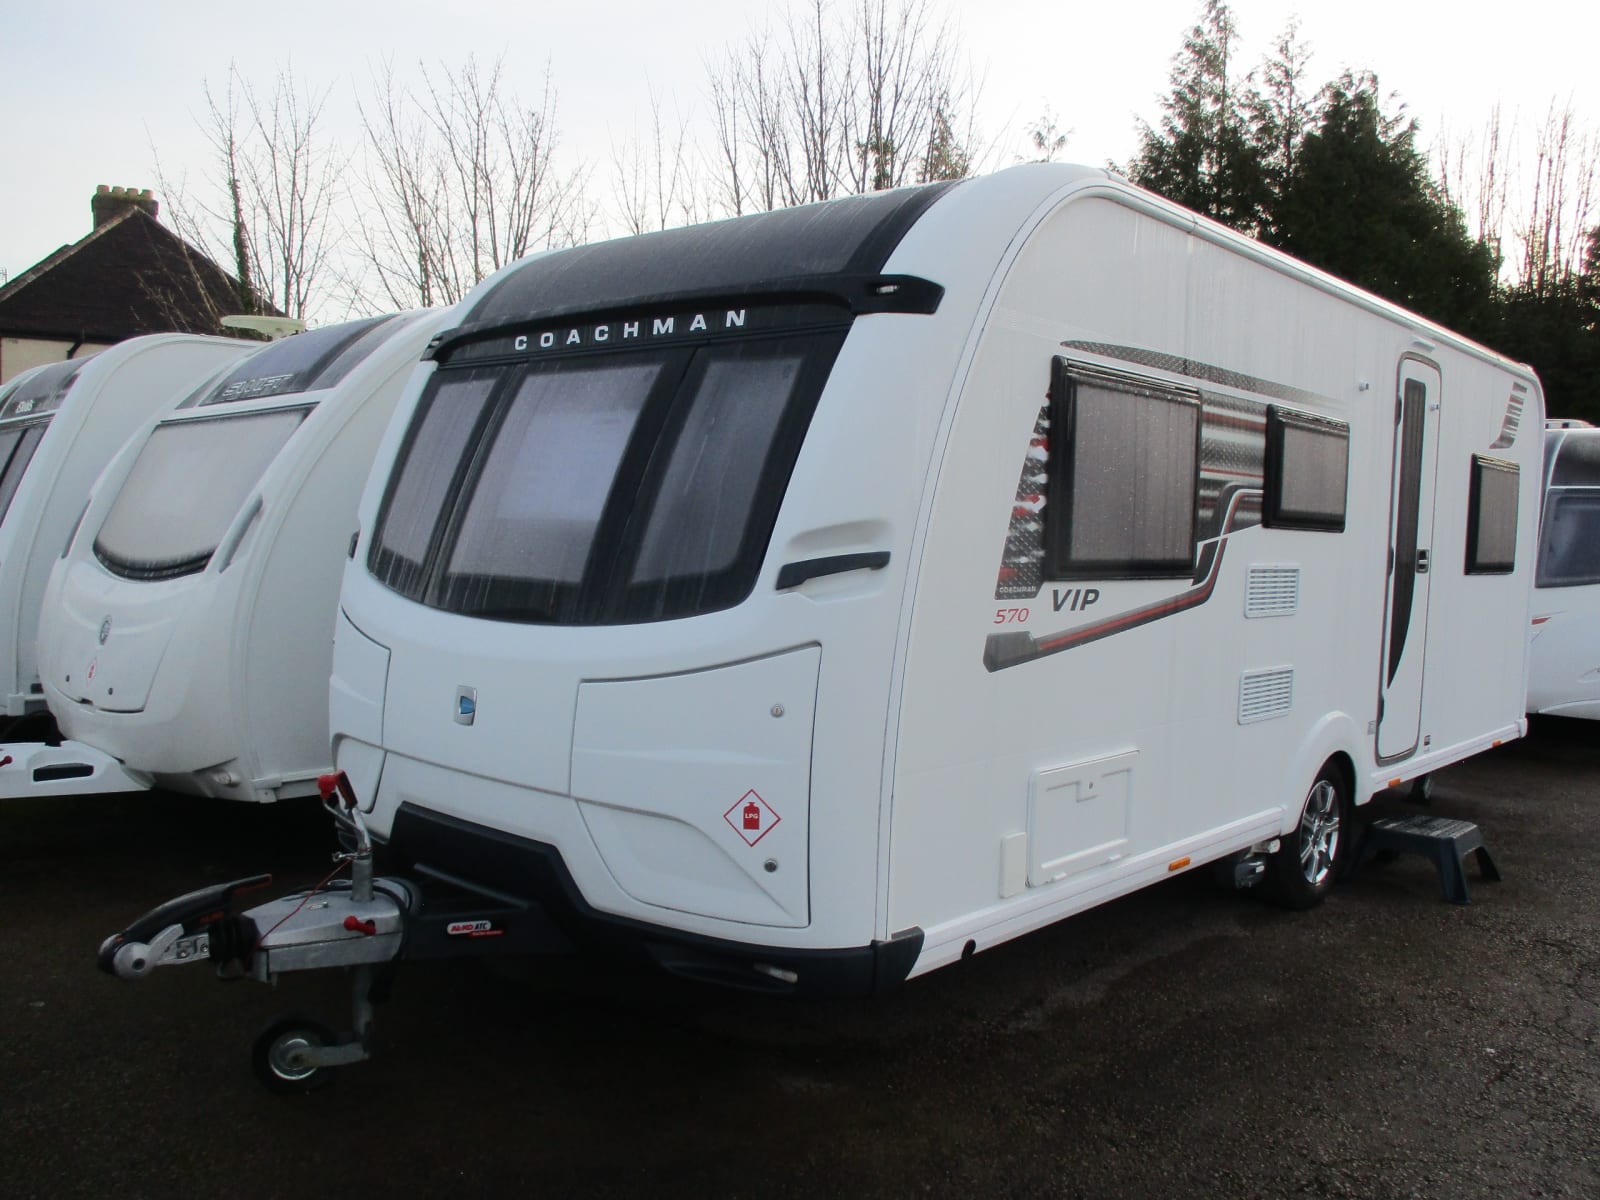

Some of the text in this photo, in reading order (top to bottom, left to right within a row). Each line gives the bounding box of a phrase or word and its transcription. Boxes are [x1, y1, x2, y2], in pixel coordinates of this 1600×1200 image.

[514, 309, 746, 351] COACHMAN
[1052, 588, 1100, 612] VIP
[993, 608, 1030, 625] 570
